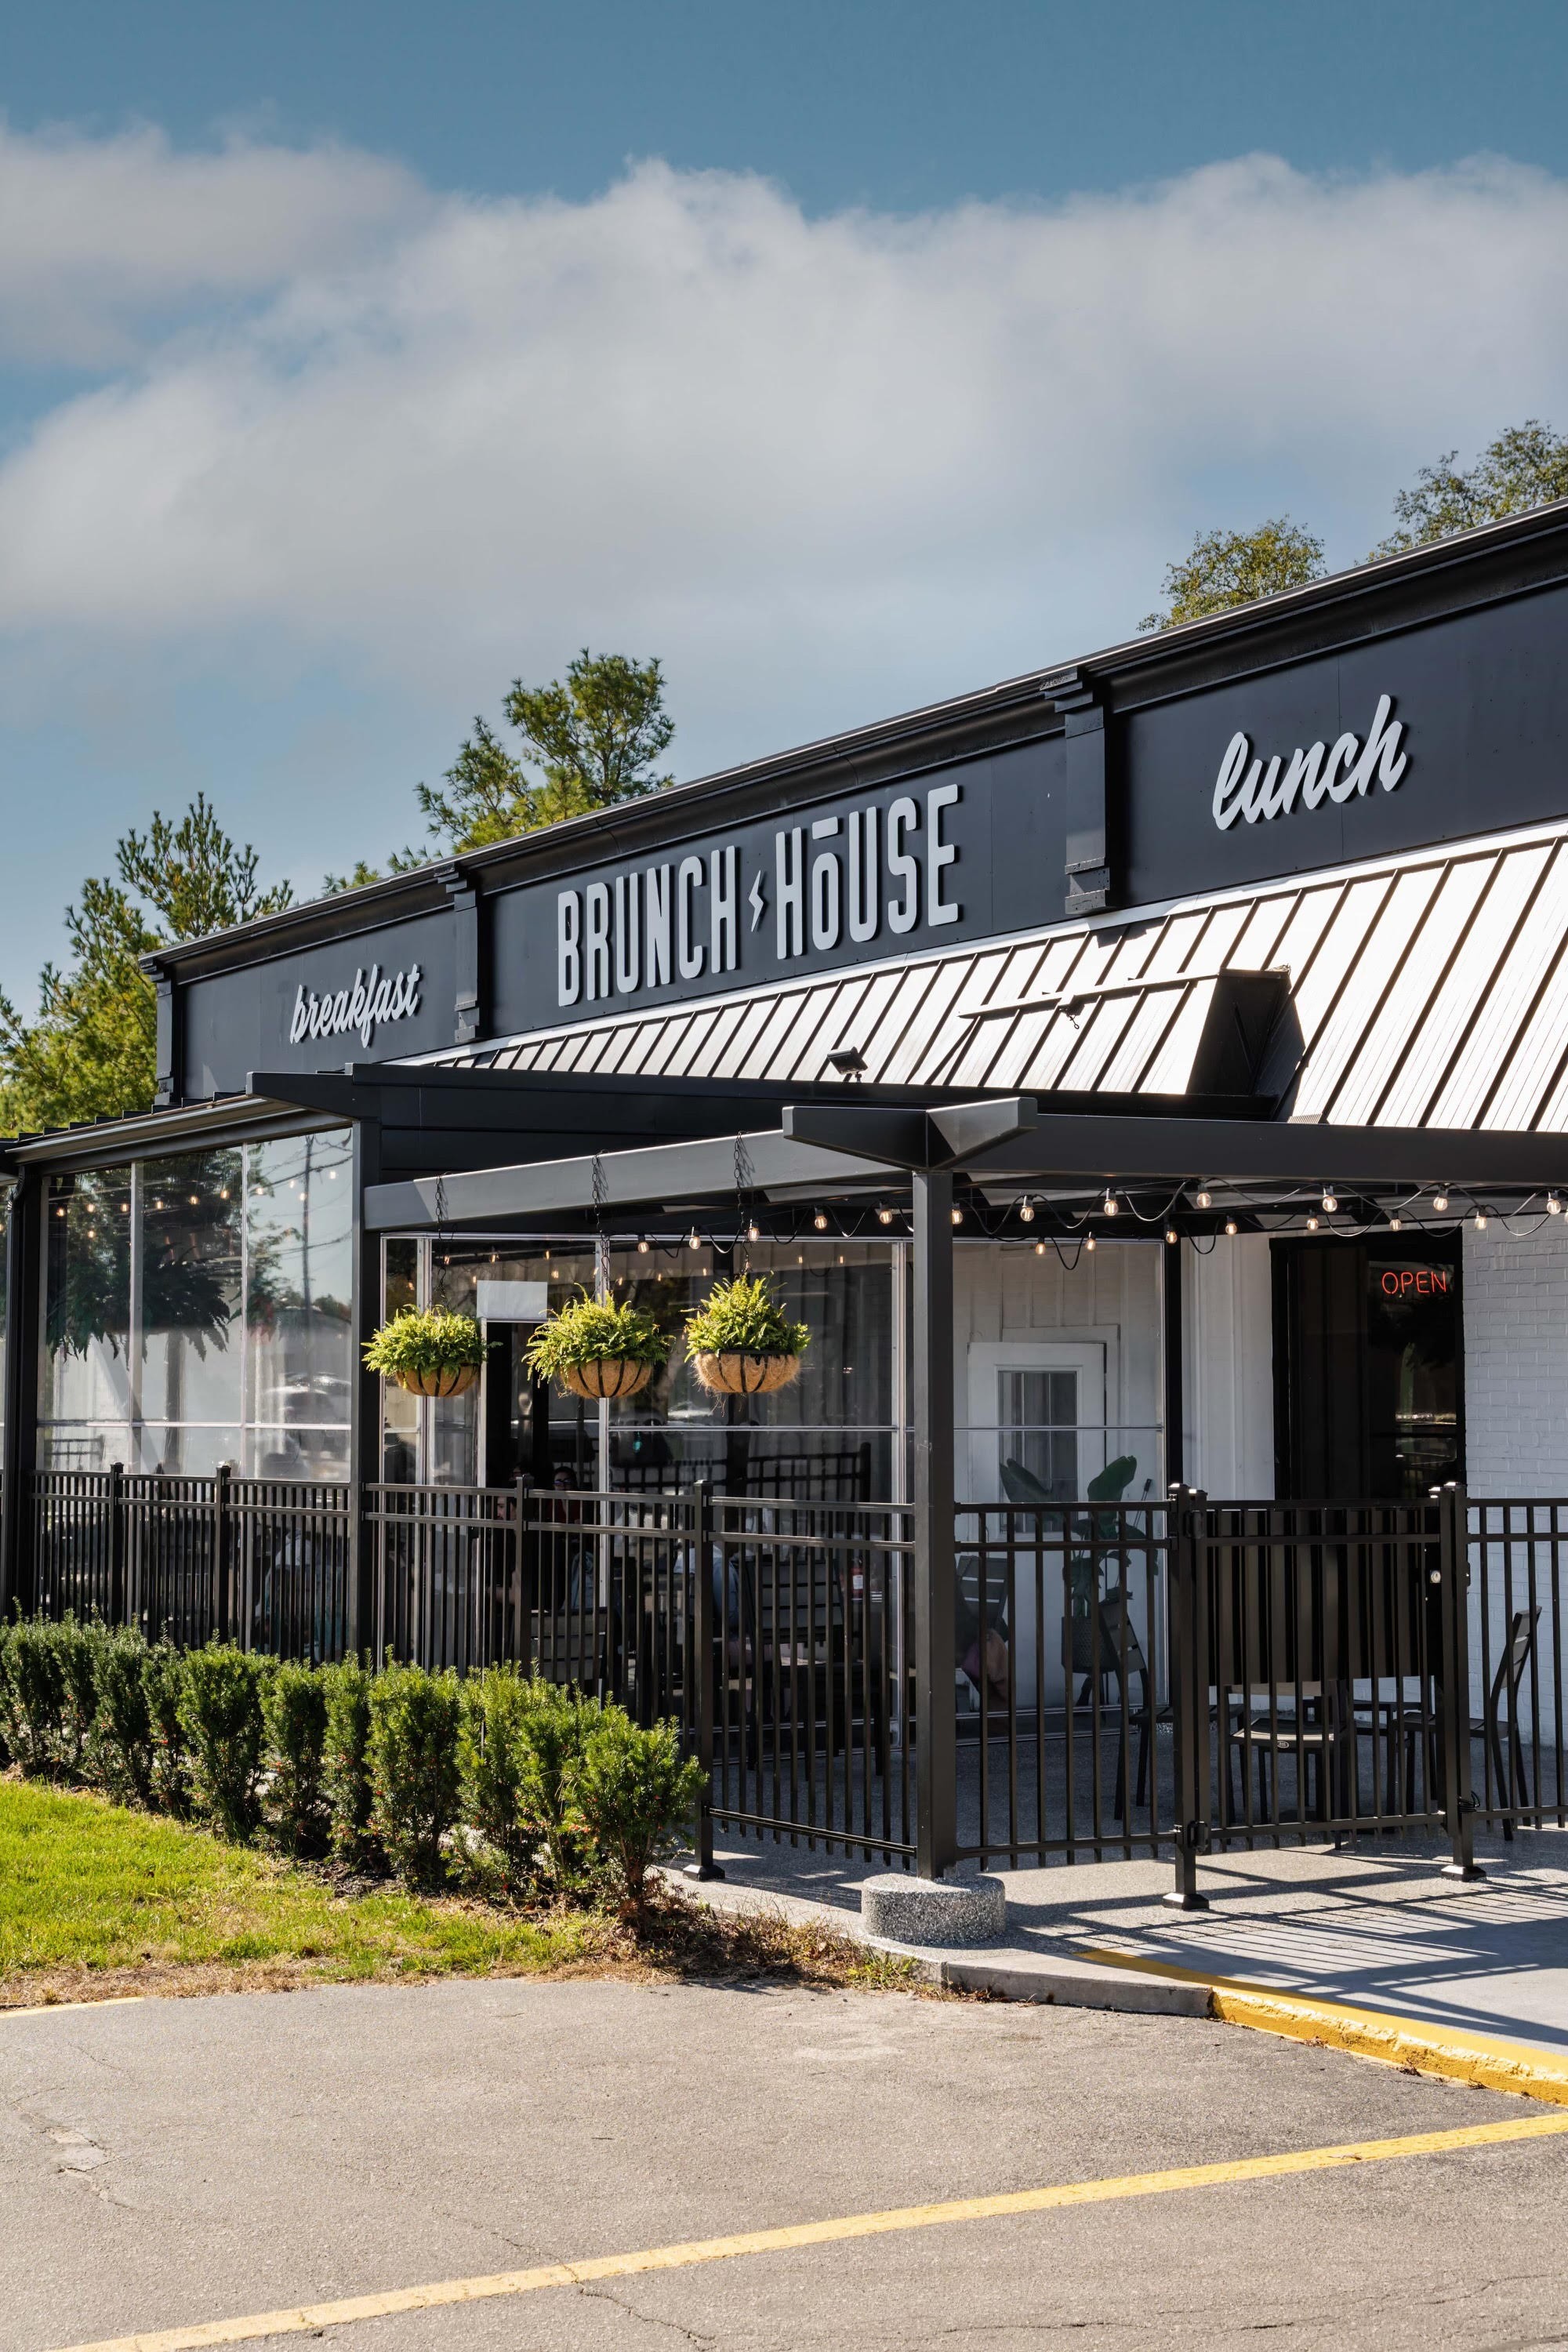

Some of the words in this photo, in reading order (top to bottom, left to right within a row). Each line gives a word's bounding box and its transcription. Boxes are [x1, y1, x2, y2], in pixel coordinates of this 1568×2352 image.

[1212, 694, 1406, 830] lunch
[557, 845, 736, 1007] BRUNCH
[289, 963, 420, 1049] breakfast
[1381, 1270, 1446, 1294] OPEN
